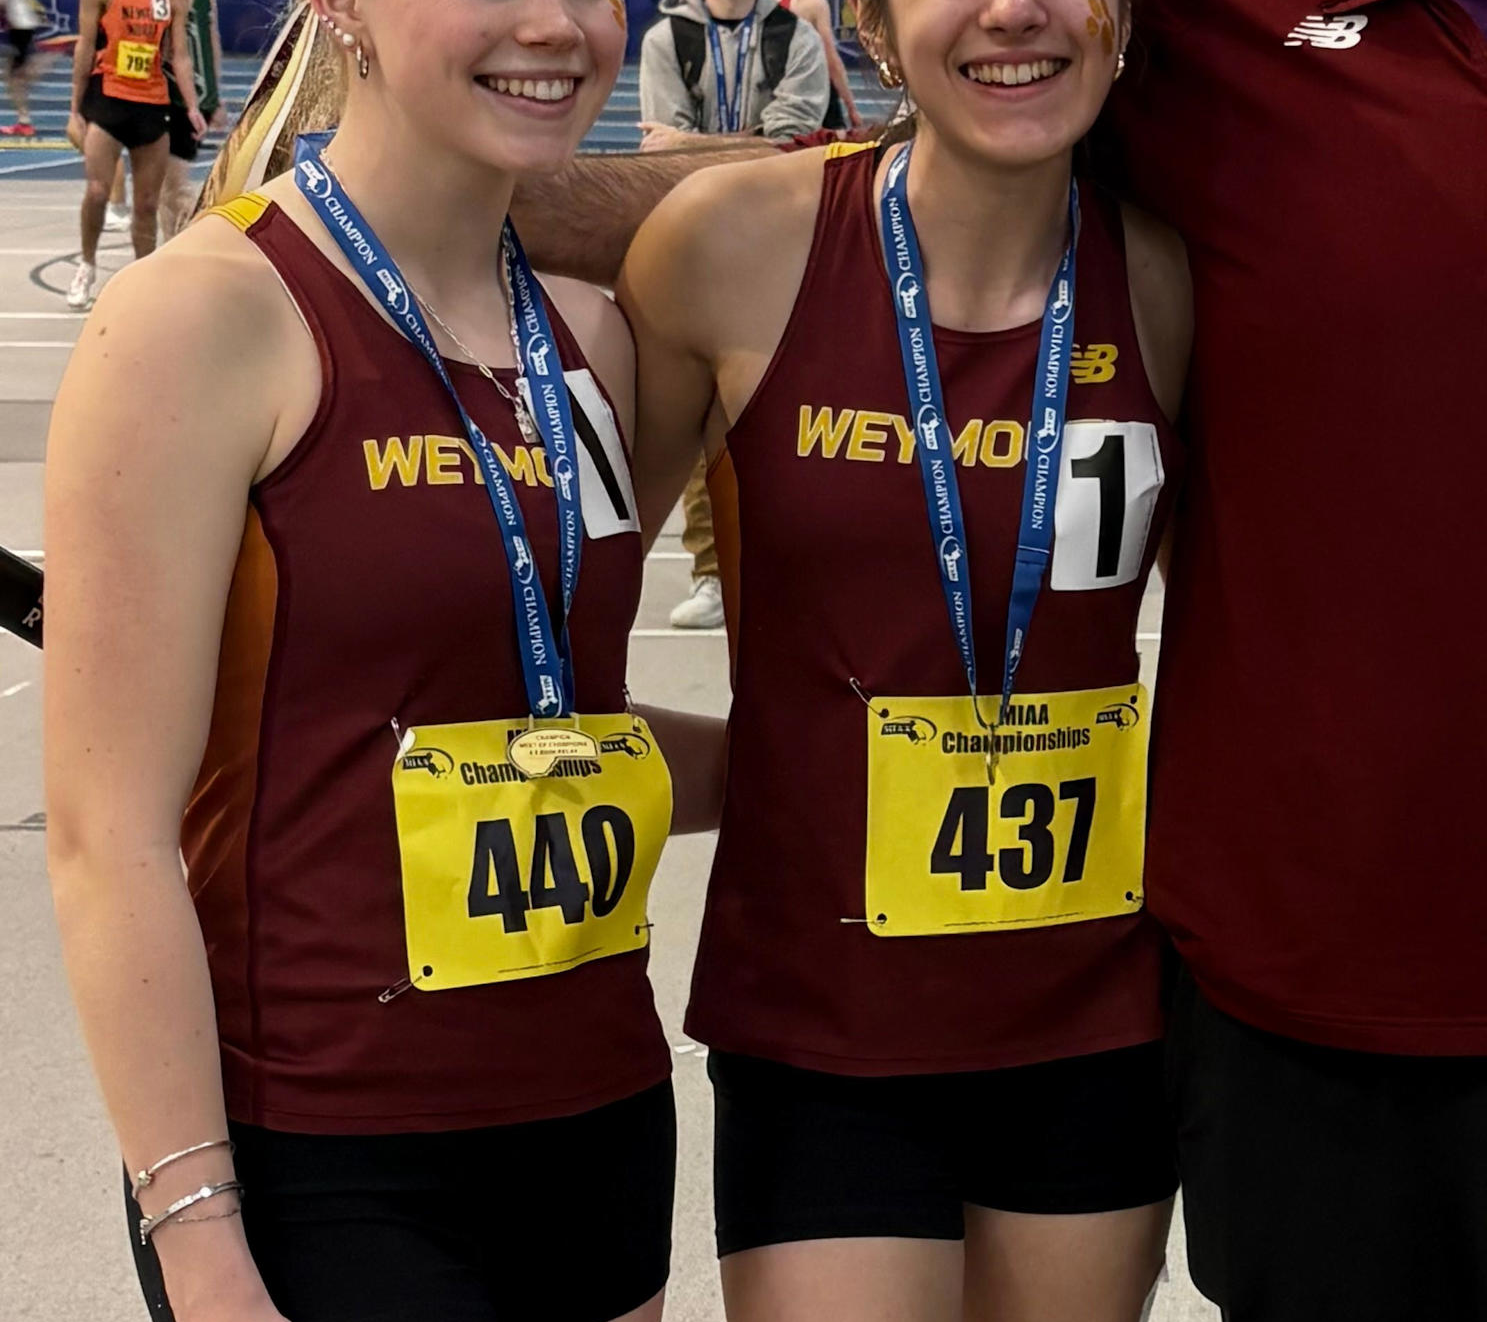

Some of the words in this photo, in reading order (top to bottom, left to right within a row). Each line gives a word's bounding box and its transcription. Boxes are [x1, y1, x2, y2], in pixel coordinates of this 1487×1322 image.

[325, 197, 377, 265] CHAMPION
[888, 197, 912, 271] CHAMPION
[909, 327, 931, 402] CHAMPION
[1045, 324, 1064, 398] CHAMPION
[542, 384, 567, 455] CHAMPION
[797, 405, 1029, 468] WEYMO
[483, 448, 517, 526] CHAMPION
[931, 459, 954, 535] CHAMPION
[1032, 454, 1050, 530] CHAMPION
[1071, 434, 1127, 578] 1
[523, 586, 547, 665] CHAMPION
[468, 805, 636, 934] 440
[930, 777, 1097, 891] 437
